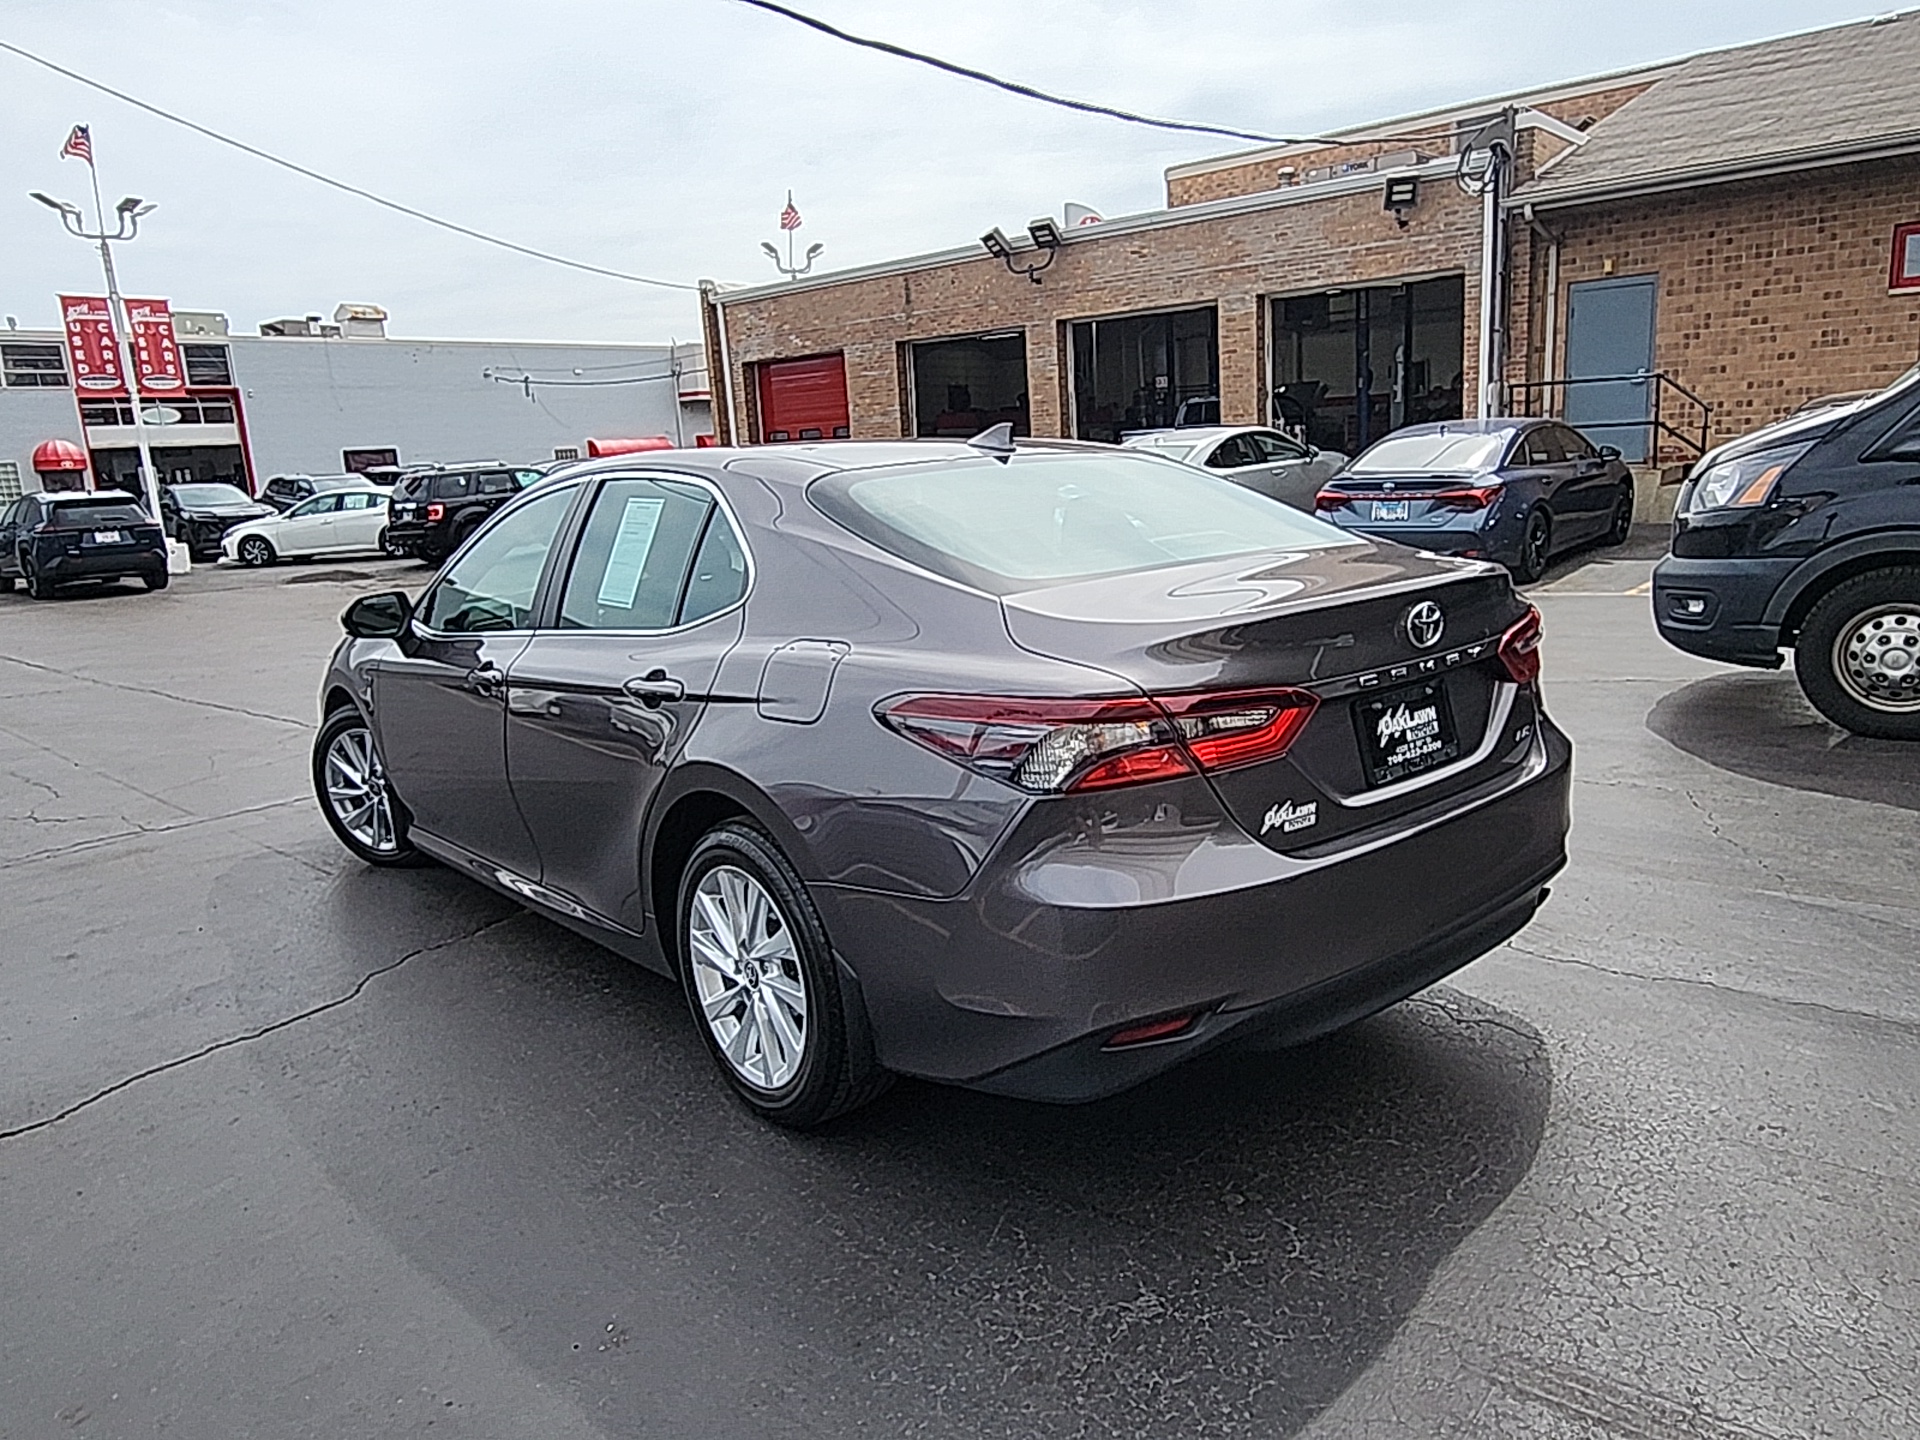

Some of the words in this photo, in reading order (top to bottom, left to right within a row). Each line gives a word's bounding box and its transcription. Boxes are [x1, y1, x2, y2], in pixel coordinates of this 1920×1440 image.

[69, 322, 90, 374] USED
[97, 322, 116, 374] CARS
[134, 323, 153, 374] USED
[158, 324, 176, 375] CARS
